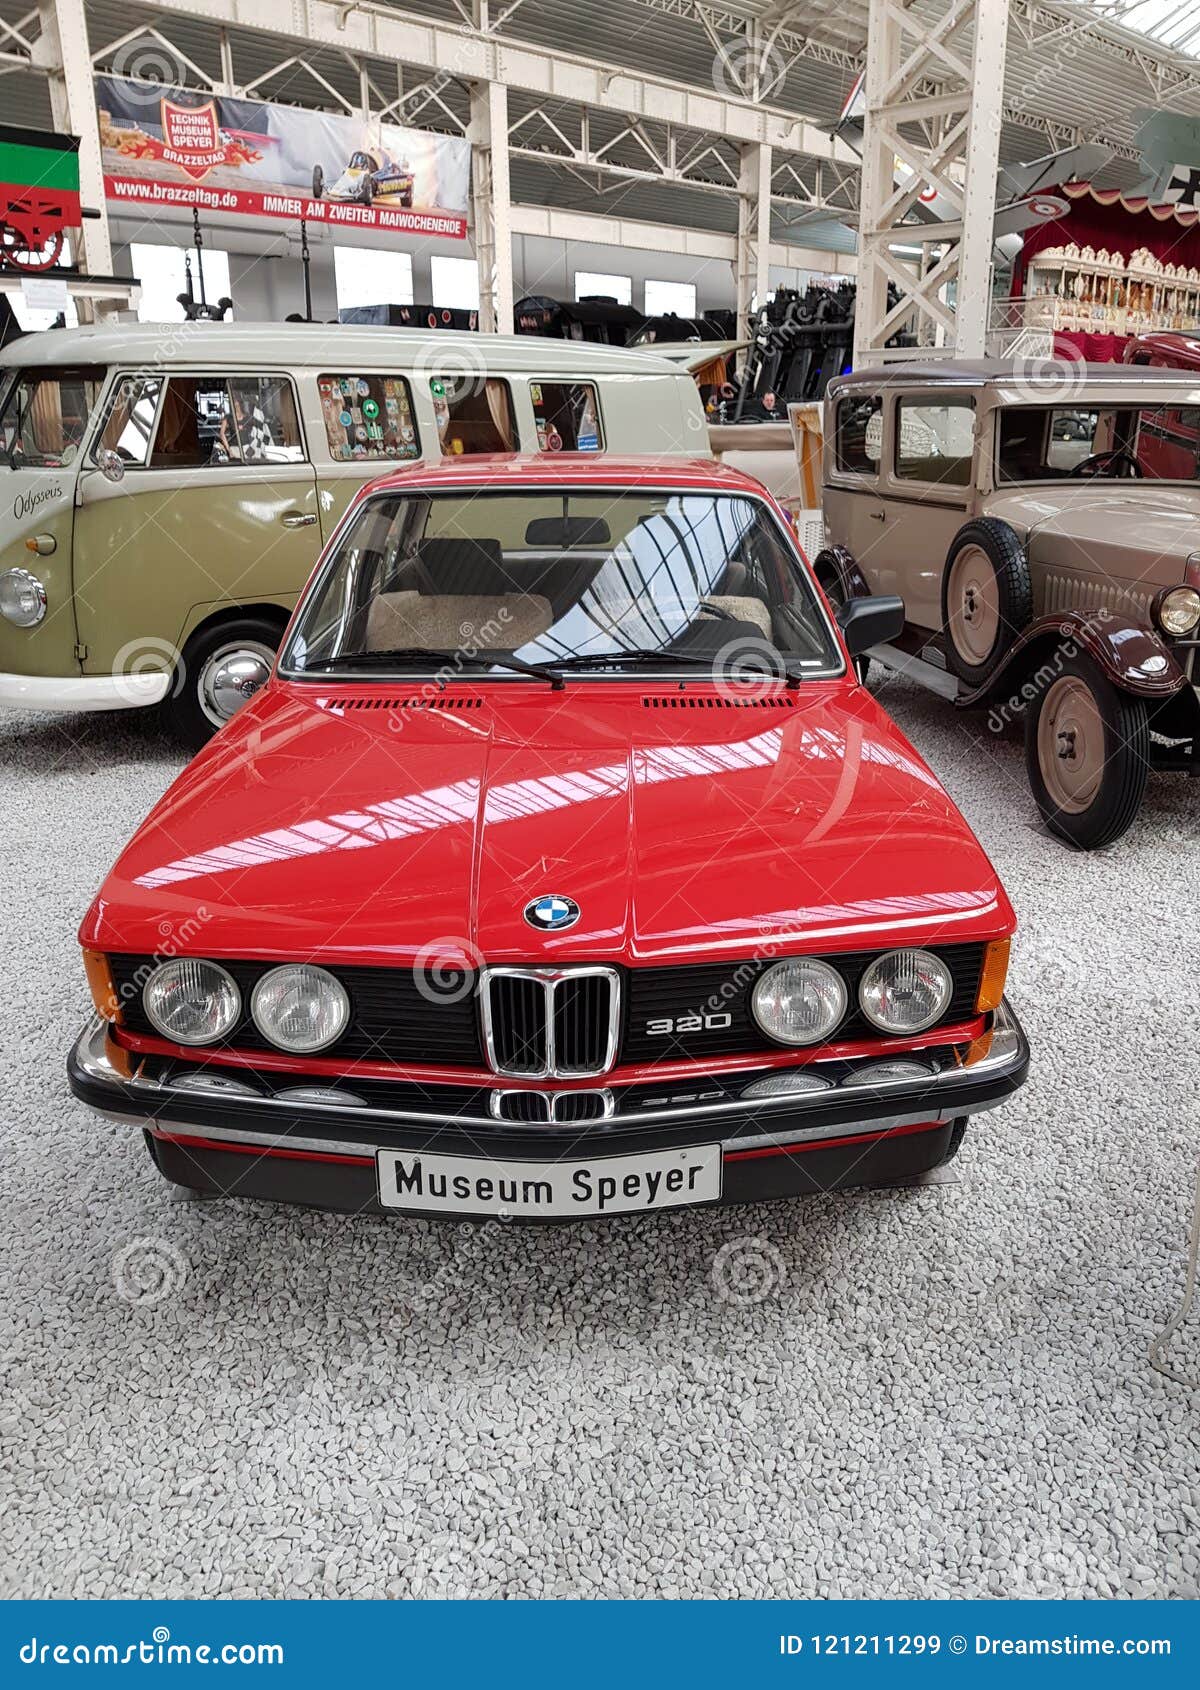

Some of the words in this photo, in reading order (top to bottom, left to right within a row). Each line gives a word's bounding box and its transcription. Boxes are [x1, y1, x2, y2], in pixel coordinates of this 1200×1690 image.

[170, 114, 210, 125] TECHNIK
[171, 125, 212, 136] MUSEUM
[173, 136, 213, 148] SPEYER
[162, 149, 226, 166] BRAZZELTAG
[114, 182, 238, 207] www.brazzeltag.de
[263, 196, 302, 215] IMMER
[306, 202, 325, 218] AM
[329, 204, 376, 224] ZWEITEN
[379, 211, 461, 235] MAIWOCHENENDE
[14, 486, 63, 520] Odysseus
[646, 1012, 732, 1036] 320
[395, 1160, 553, 1203] Museum
[571, 1165, 705, 1210] Speyer
